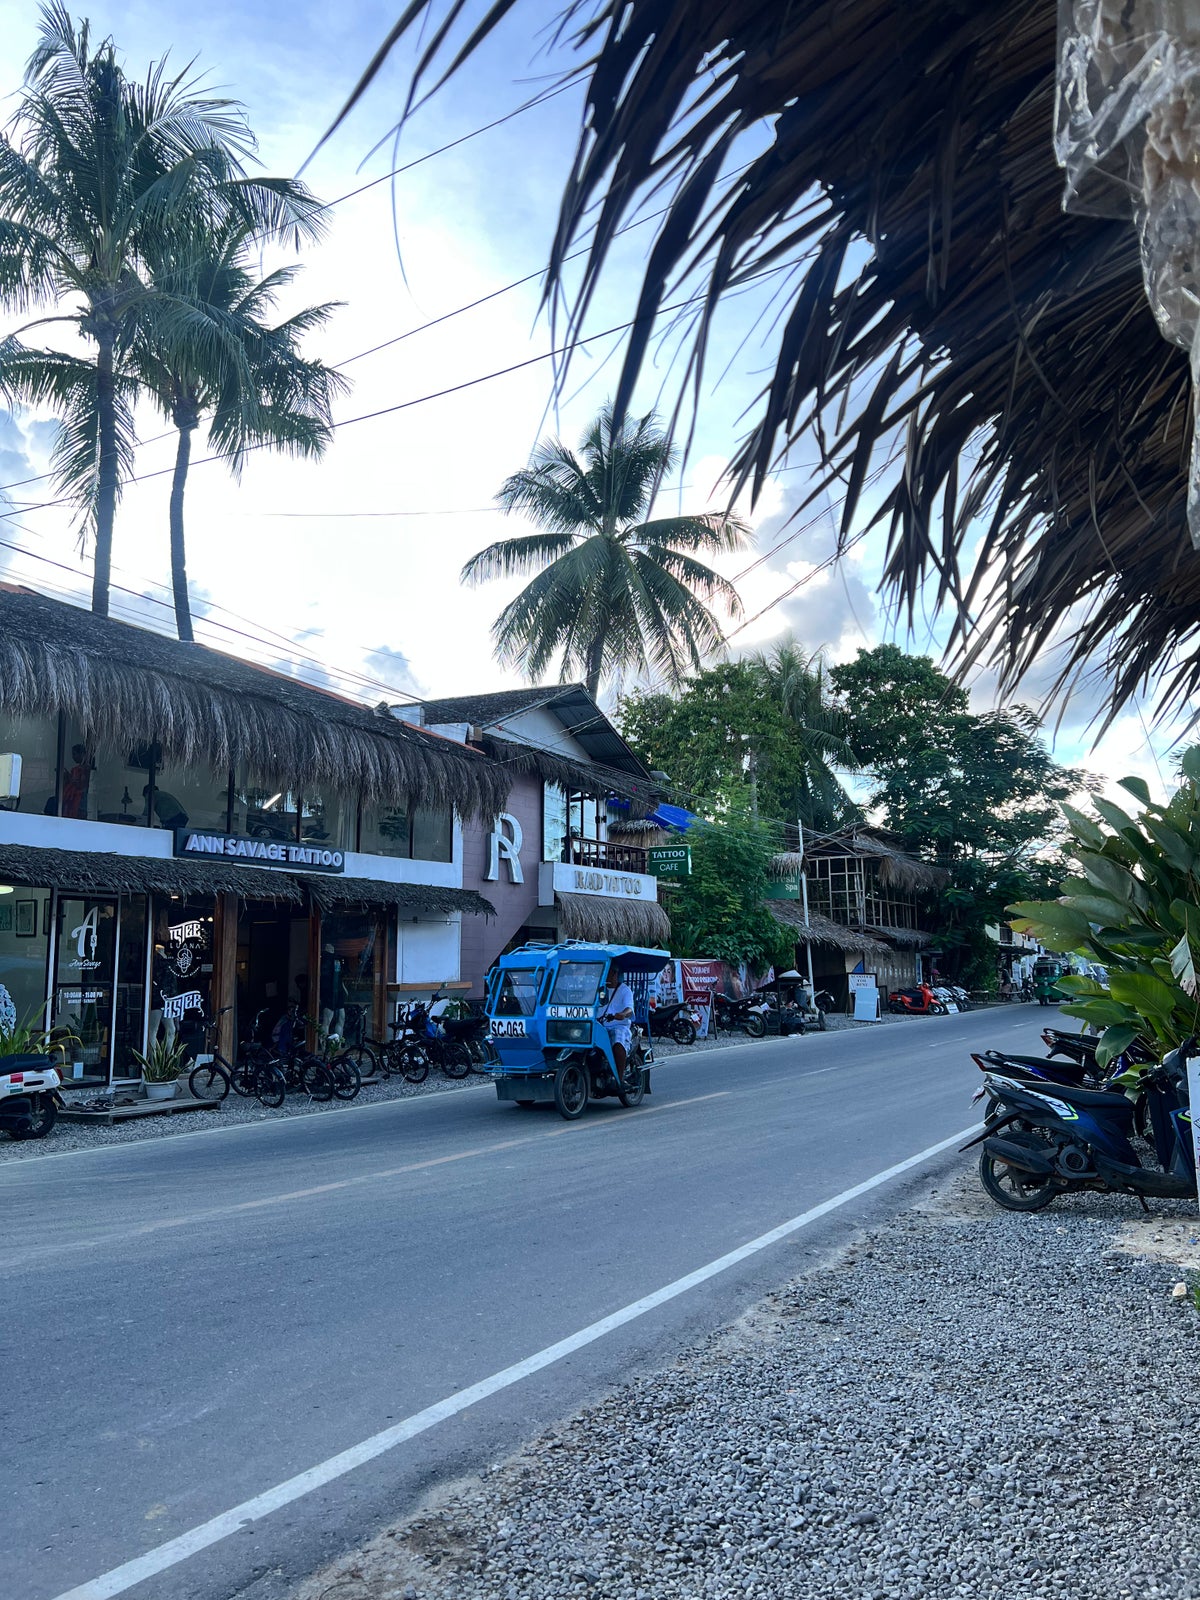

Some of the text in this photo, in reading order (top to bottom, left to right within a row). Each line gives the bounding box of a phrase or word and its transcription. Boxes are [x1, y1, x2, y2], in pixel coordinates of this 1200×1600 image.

[185, 834, 343, 867] ANN SAVAGE TATTOO
[652, 850, 685, 859] TATTOO
[660, 863, 678, 871] CAFE
[604, 874, 642, 895] TATTOO
[785, 884, 798, 892] Spa
